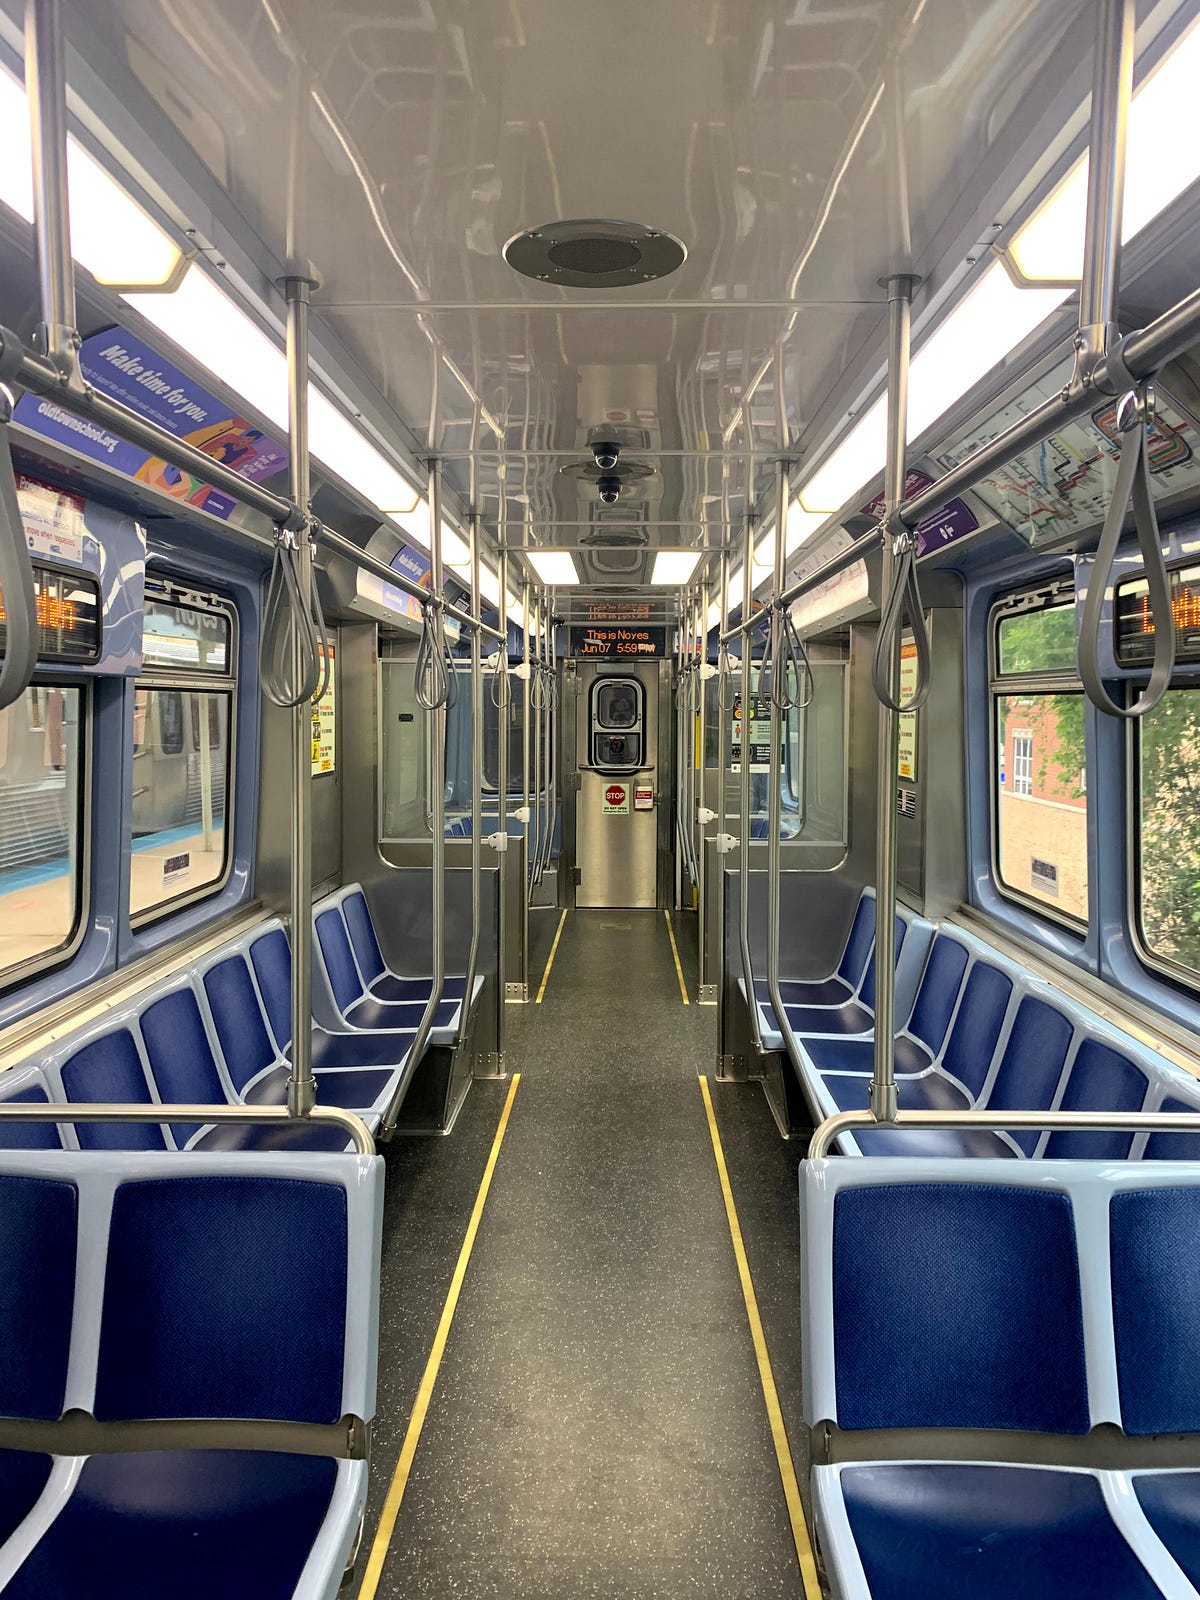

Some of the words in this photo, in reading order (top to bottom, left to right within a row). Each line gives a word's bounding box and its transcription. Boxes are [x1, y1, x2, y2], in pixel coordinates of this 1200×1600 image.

[98, 344, 144, 376] Make
[135, 370, 171, 396] time
[164, 388, 189, 407] for
[587, 629, 607, 640] This
[608, 630, 616, 640] is
[617, 629, 649, 640] Noyes
[581, 643, 598, 653] Jun
[599, 643, 611, 653] 07
[606, 792, 625, 800] STOP
